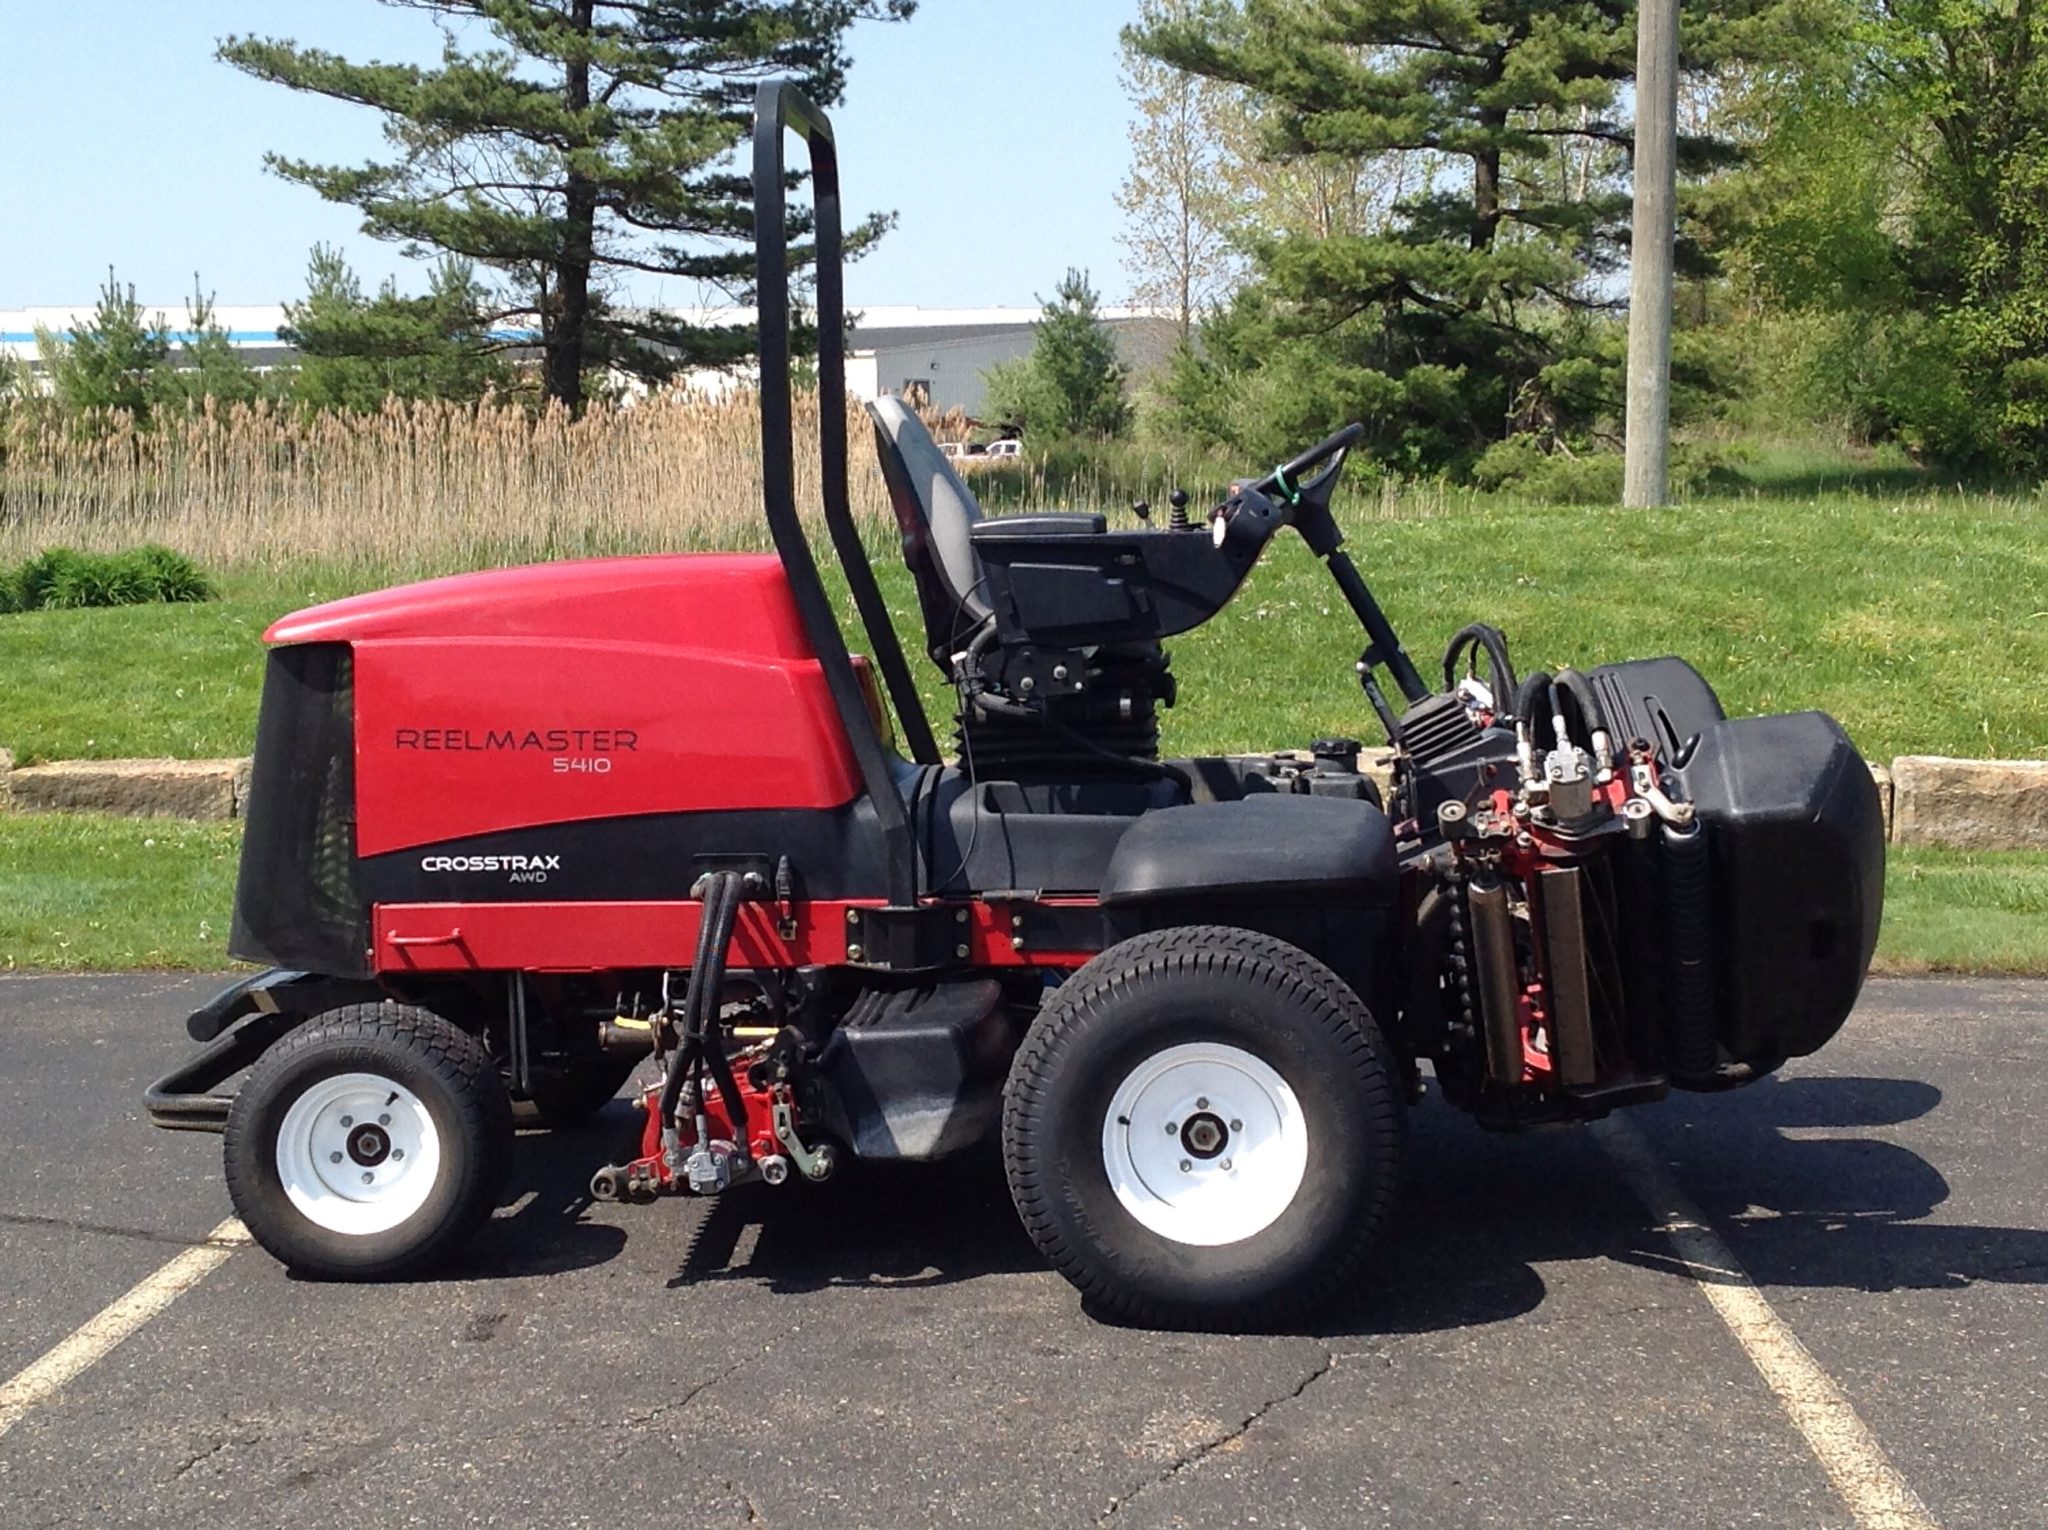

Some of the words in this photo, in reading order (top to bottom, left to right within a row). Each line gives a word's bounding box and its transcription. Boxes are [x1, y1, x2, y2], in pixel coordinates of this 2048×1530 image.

[396, 729, 639, 751] REELMASTER
[552, 758, 612, 773] 5410
[421, 855, 561, 872] CROSSTRAX
[508, 871, 548, 884] AWD
